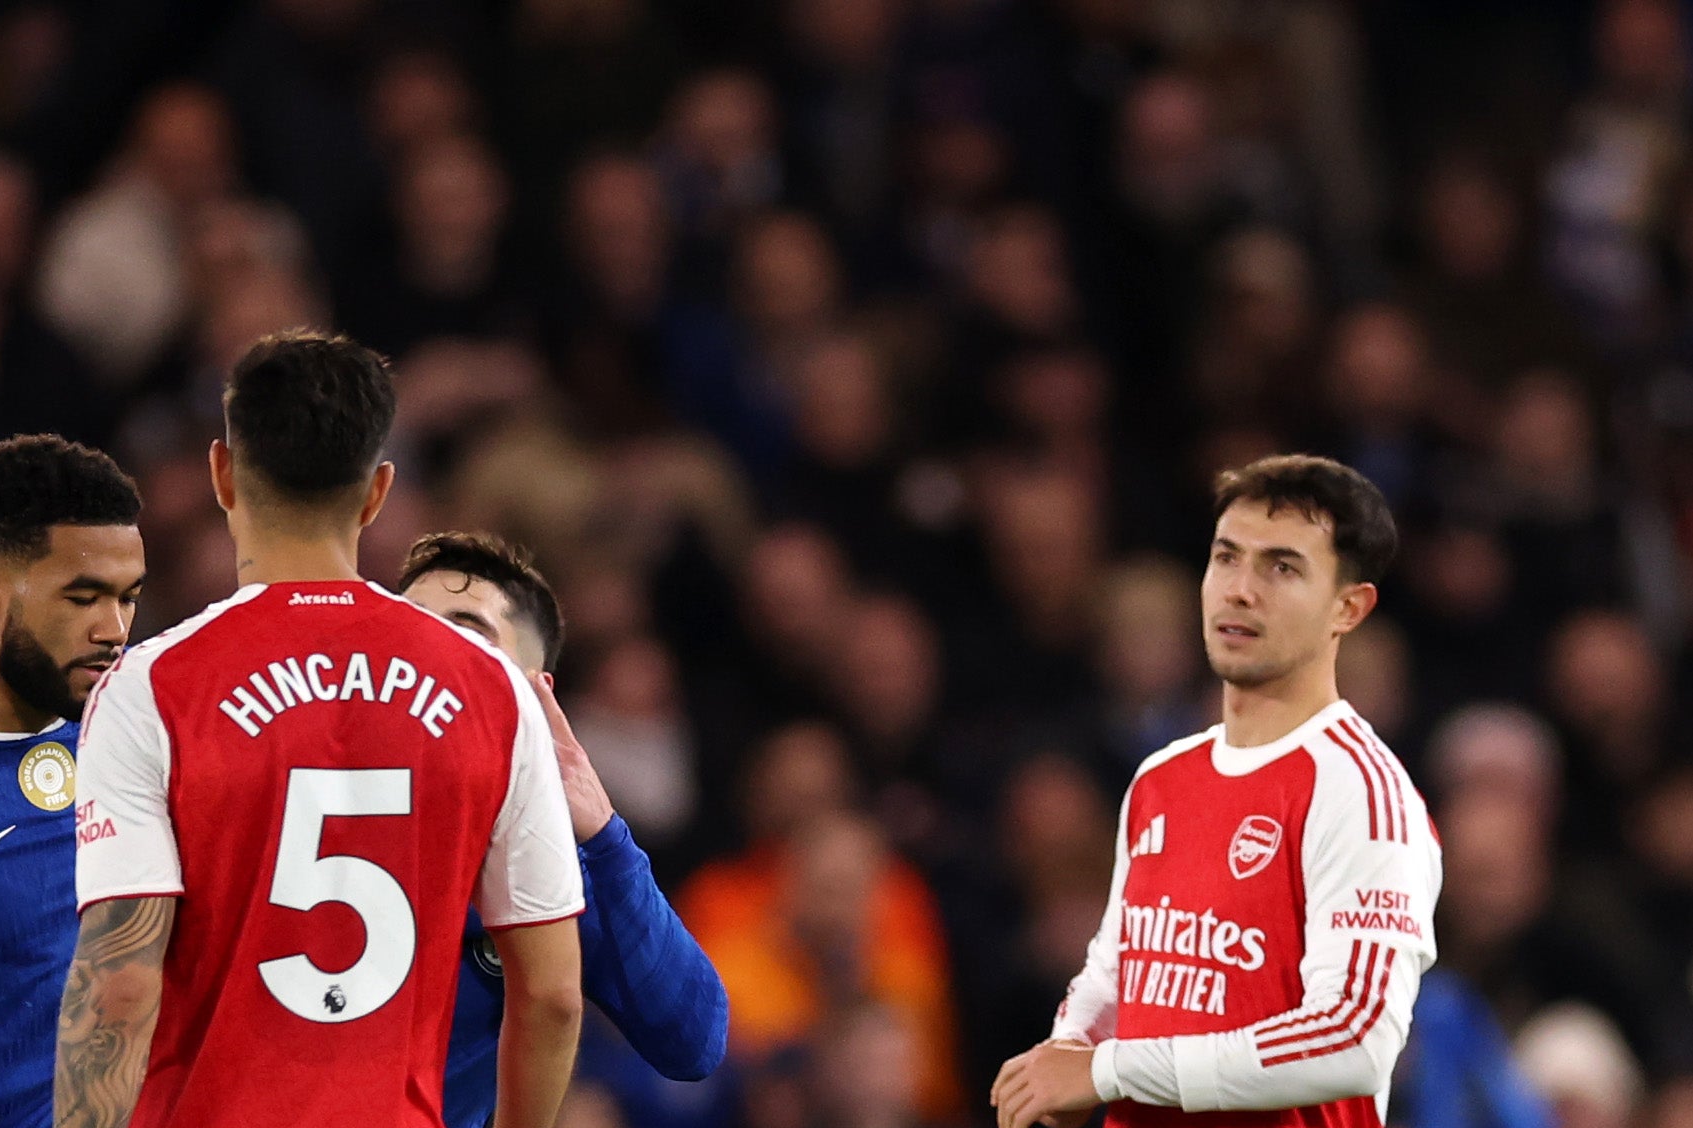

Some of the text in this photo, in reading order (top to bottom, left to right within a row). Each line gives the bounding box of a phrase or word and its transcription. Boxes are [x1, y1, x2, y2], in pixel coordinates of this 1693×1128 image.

[287, 591, 356, 606] Arsenal
[219, 652, 463, 739] HINCAPIE
[75, 799, 96, 827] SIT
[76, 817, 117, 849] NDA
[257, 767, 417, 1024] 5
[1355, 888, 1411, 912] VISIT
